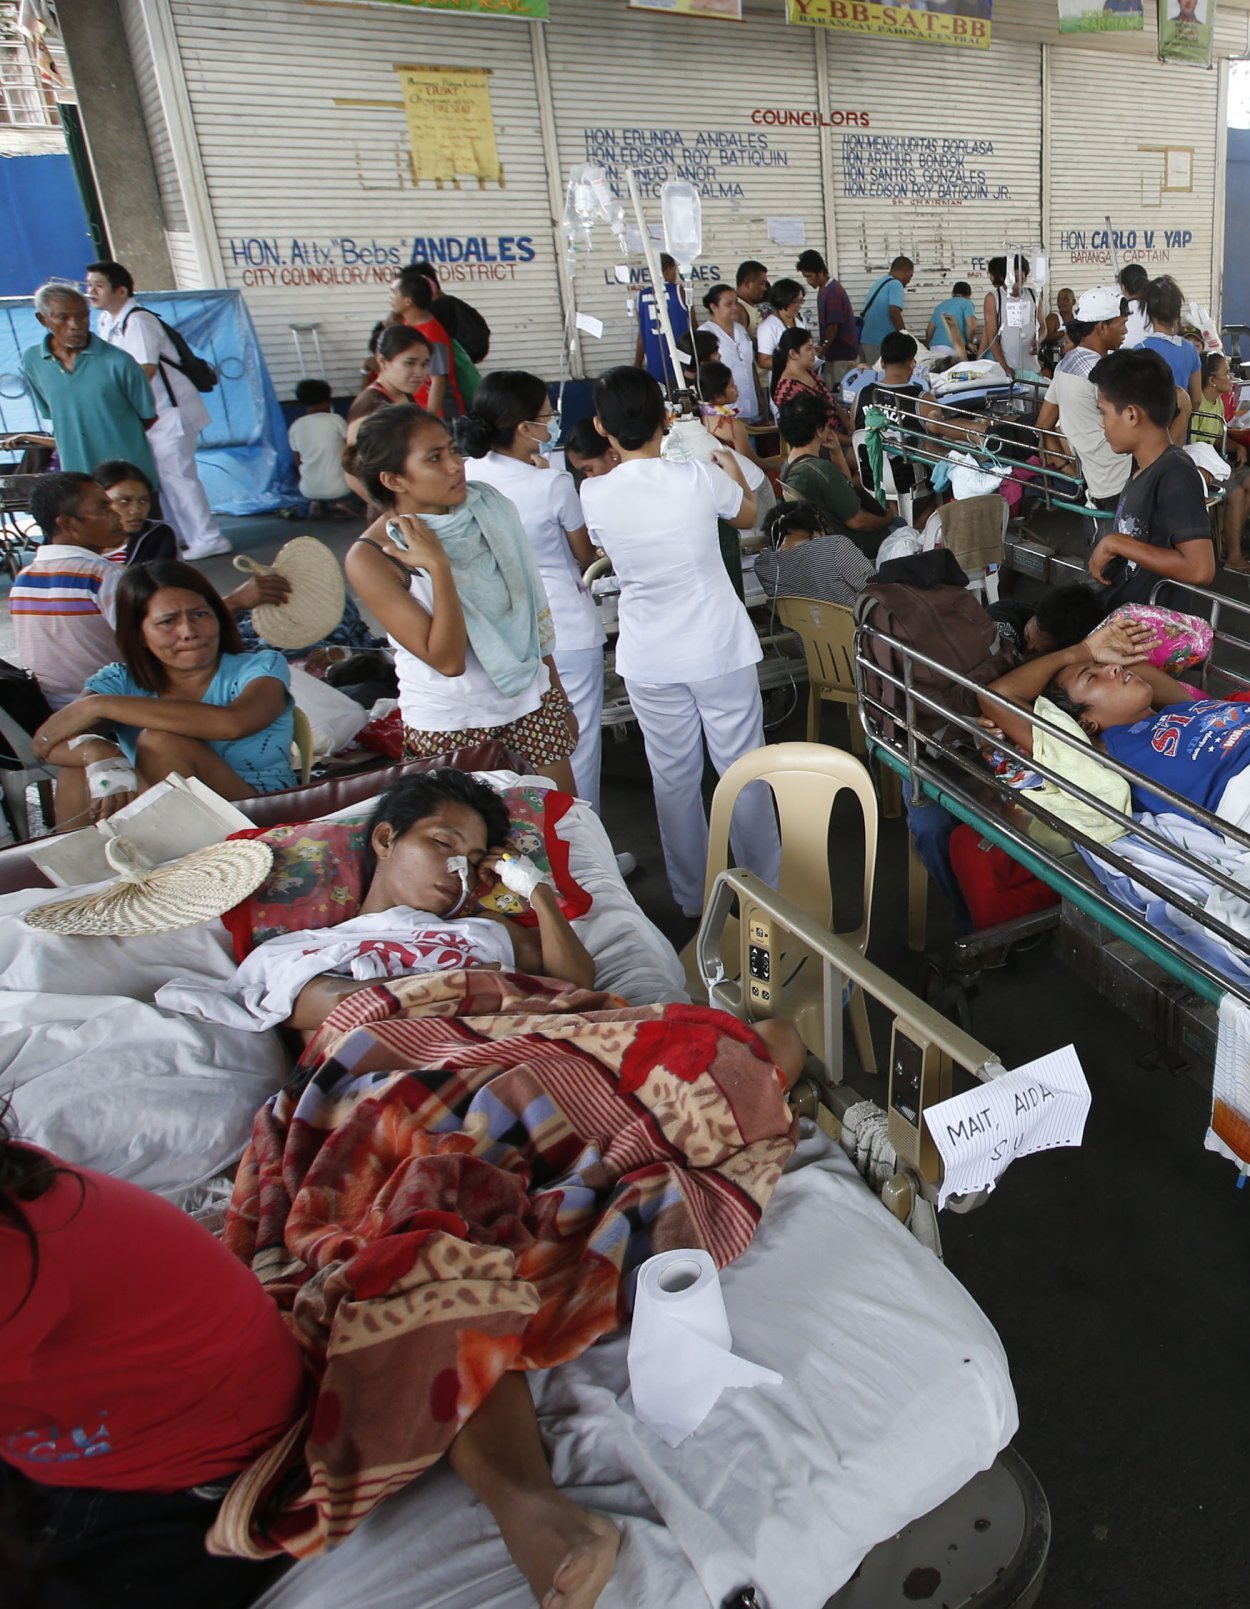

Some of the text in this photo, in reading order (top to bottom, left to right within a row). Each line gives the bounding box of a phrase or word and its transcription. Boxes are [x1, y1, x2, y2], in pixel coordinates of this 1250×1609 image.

[751, 109, 870, 127] COUNCILORS
[584, 129, 769, 149] HON. ERLINDA ANDALES
[843, 134, 866, 150] HON.
[942, 139, 994, 155] BORLASA
[586, 147, 788, 166] HON. EDISON ROY BATIQUIN
[843, 151, 866, 166] HON.
[868, 152, 913, 167] ARTHUR
[844, 167, 986, 185] HON. SANTOS GONZALES
[844, 183, 1012, 200] HON. EDISON ROY BATIQUIN JR.
[1061, 230, 1193, 250] HON. CARLO V. YAP
[230, 239, 287, 266] HON.
[411, 237, 536, 263] ANDALES
[1123, 249, 1170, 263] CAPTAIN
[242, 268, 277, 287] CITY
[438, 263, 518, 283] DISTRICT
[946, 1083, 1055, 1146] MAIT, AIDA
